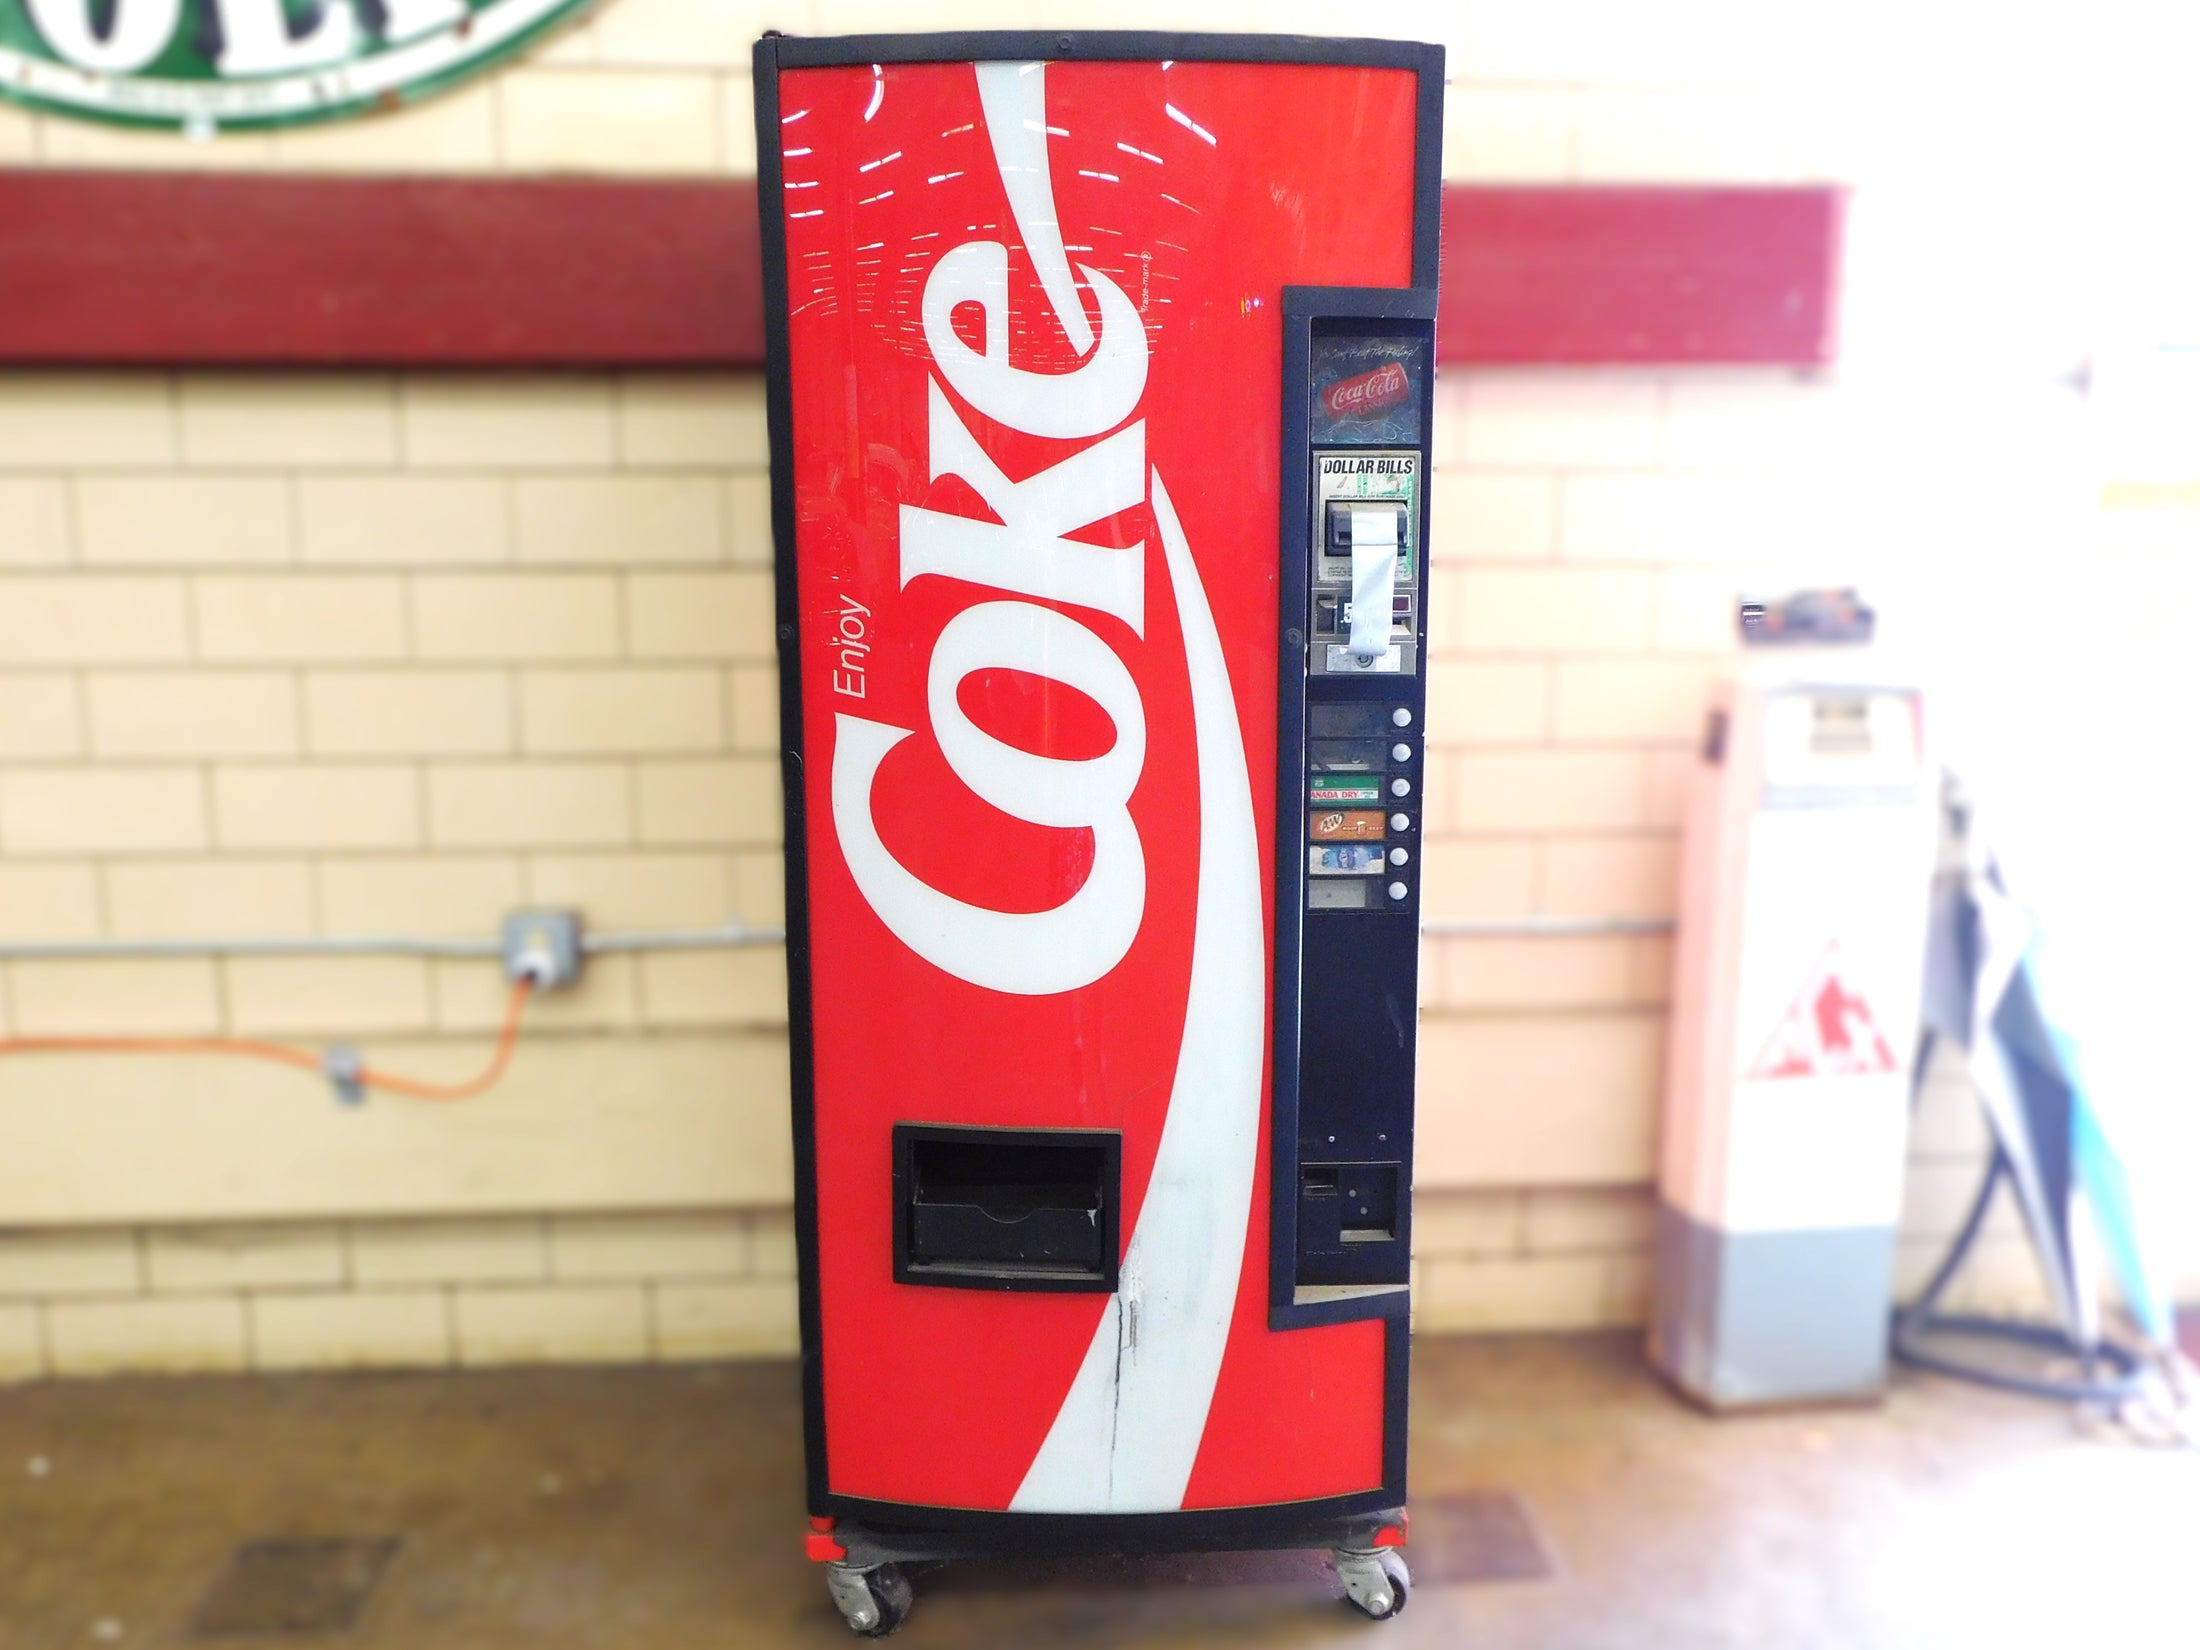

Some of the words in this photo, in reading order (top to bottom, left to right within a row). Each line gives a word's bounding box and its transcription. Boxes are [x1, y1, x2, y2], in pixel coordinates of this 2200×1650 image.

[1331, 368, 1400, 411] Coca-Cola
[1323, 459, 1374, 474] DOLLAR
[1376, 459, 1413, 474] BILLS
[831, 240, 1150, 996] Coke
[832, 593, 872, 699] Enjoy
[1311, 790, 1338, 799] ANADA
[1341, 790, 1359, 799] DRY
